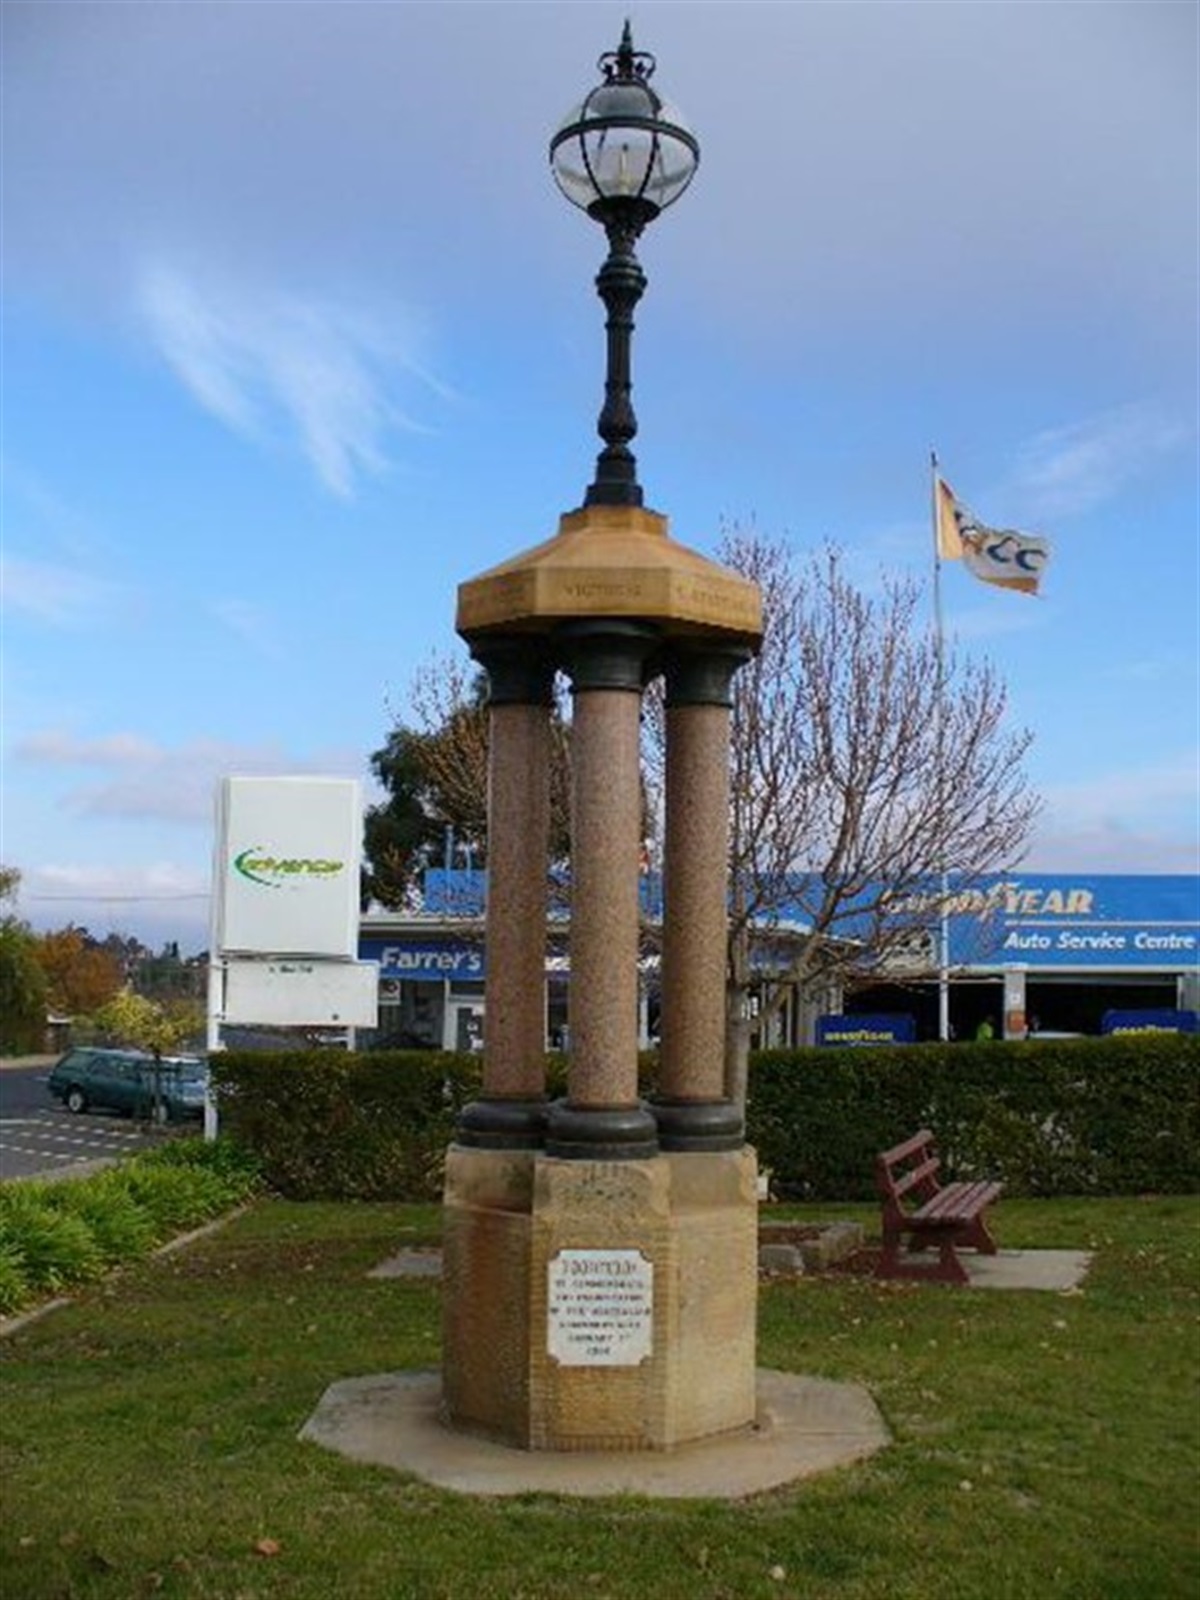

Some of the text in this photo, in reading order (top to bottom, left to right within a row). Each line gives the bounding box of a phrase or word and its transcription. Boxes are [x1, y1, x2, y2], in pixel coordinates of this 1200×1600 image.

[1003, 931, 1196, 950] Auto Service Centre
[380, 946, 482, 971] Farrer's
